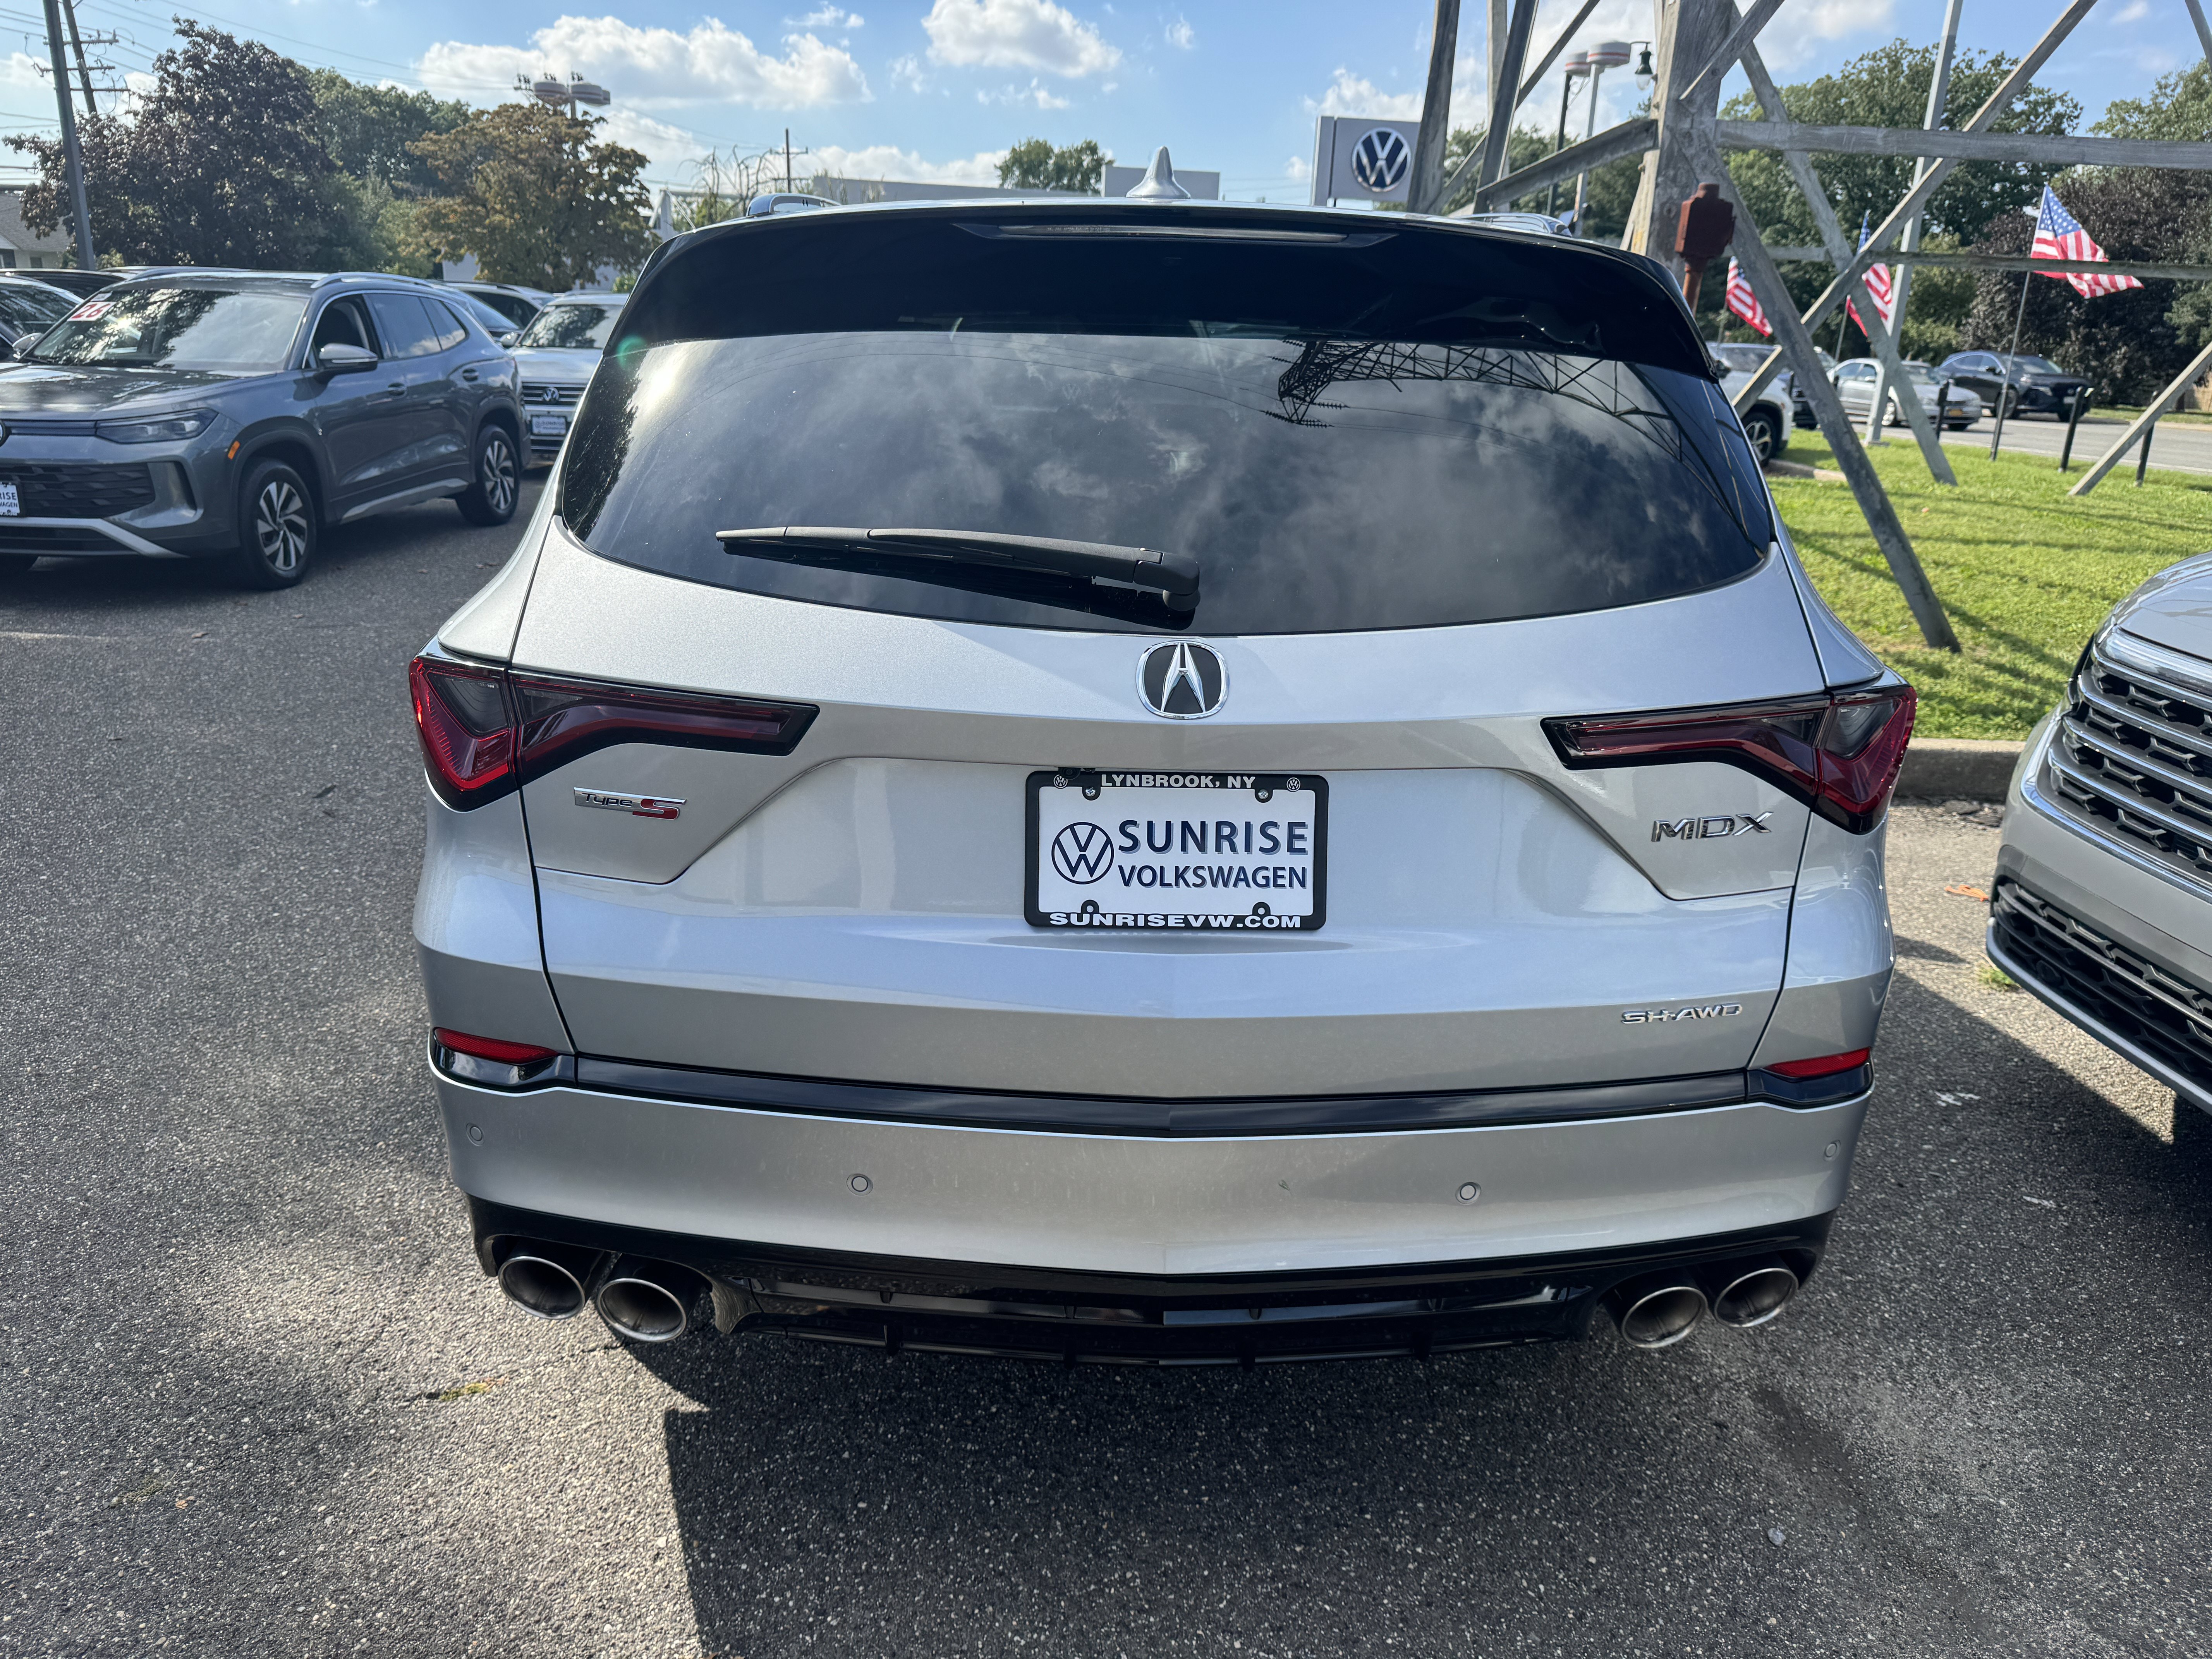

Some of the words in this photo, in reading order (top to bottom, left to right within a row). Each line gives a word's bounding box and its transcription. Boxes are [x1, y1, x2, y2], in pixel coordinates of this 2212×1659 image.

[71, 303, 111, 319] 26
[1101, 774, 1220, 788] LYNBROOK,
[1227, 776, 1256, 788] NY
[582, 792, 633, 806] Type
[632, 798, 685, 820] S
[1118, 819, 1309, 855] SUNRISE
[1651, 811, 1774, 843] MDX
[1117, 864, 1307, 889] VOLKSWAGEN
[1049, 912, 1301, 928] SUNRISEVW.COM
[1621, 1002, 1743, 1025] SH-AWD
